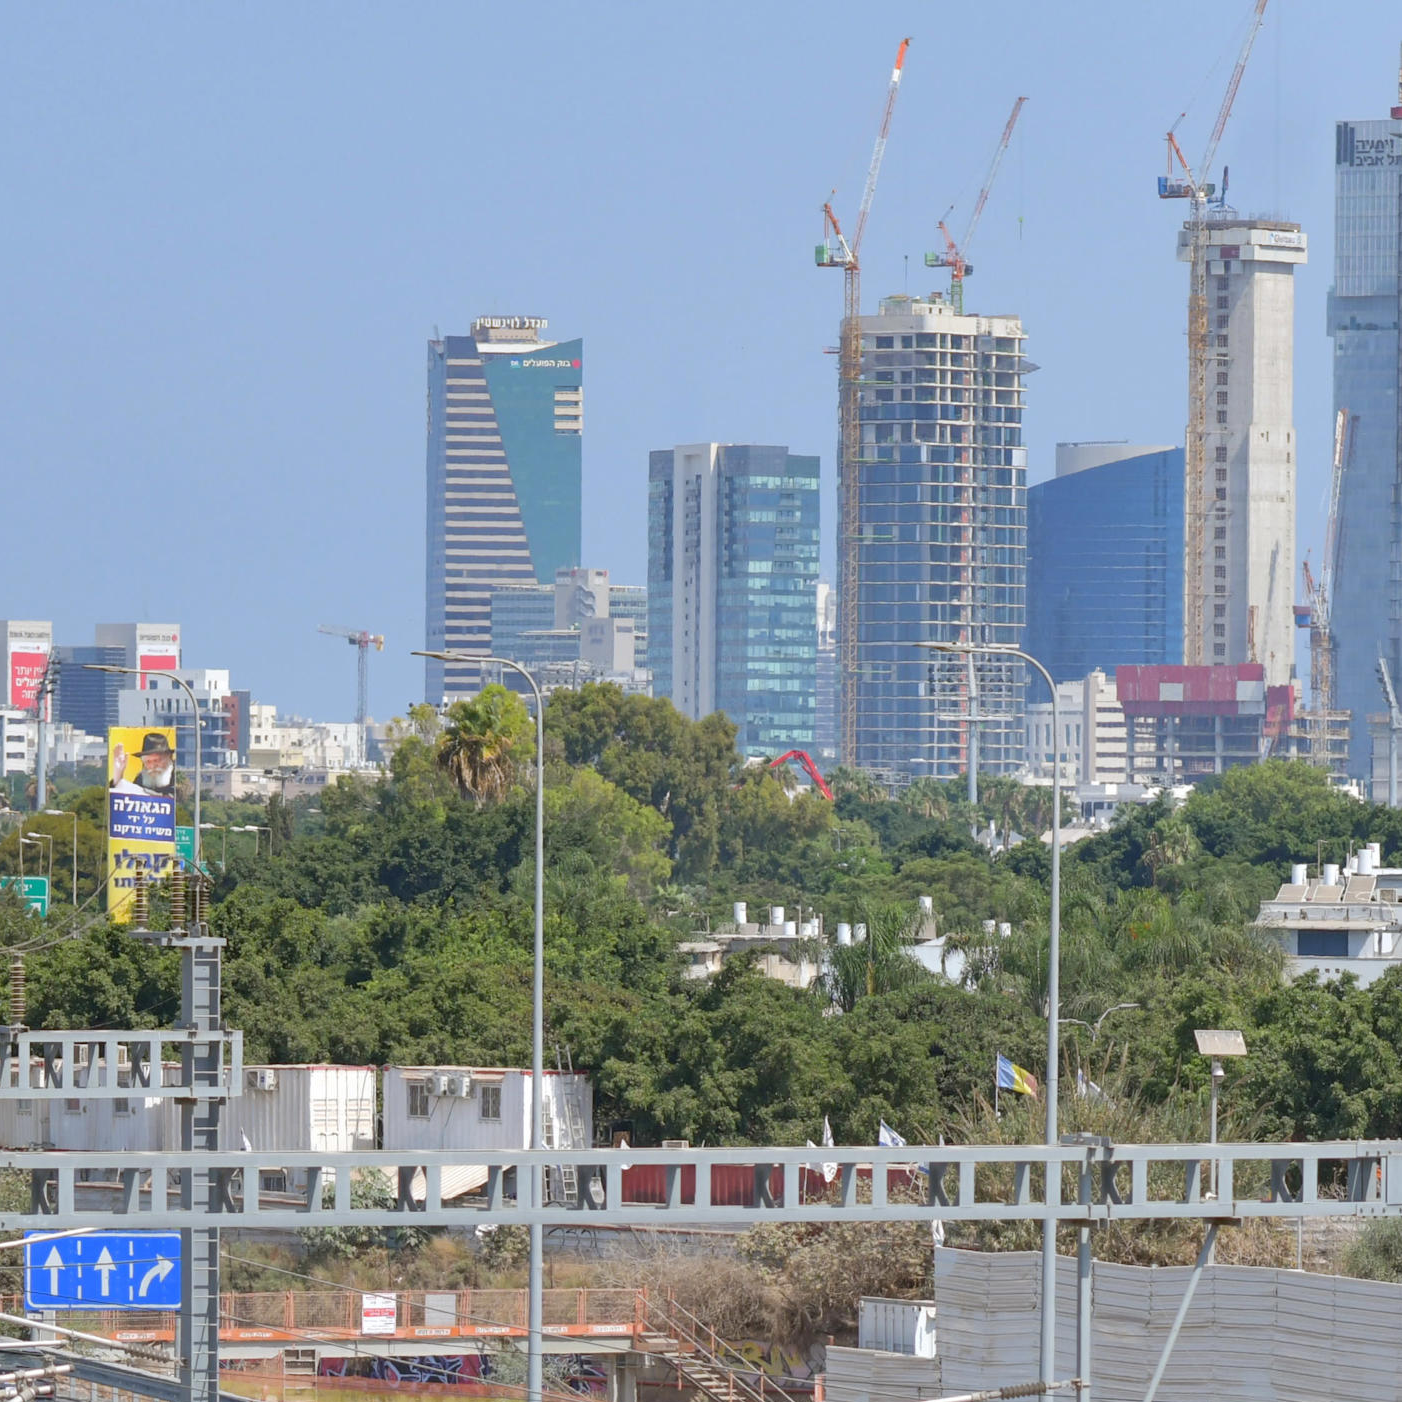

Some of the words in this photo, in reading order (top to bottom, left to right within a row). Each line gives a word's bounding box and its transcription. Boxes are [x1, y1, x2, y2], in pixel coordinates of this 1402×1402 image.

[1356, 155, 1383, 167] אביב
[523, 358, 556, 367] הפועלים
[114, 797, 171, 815] הגאולה
[127, 815, 140, 823] ידי
[143, 814, 156, 825] על
[145, 826, 172, 836] משיח
